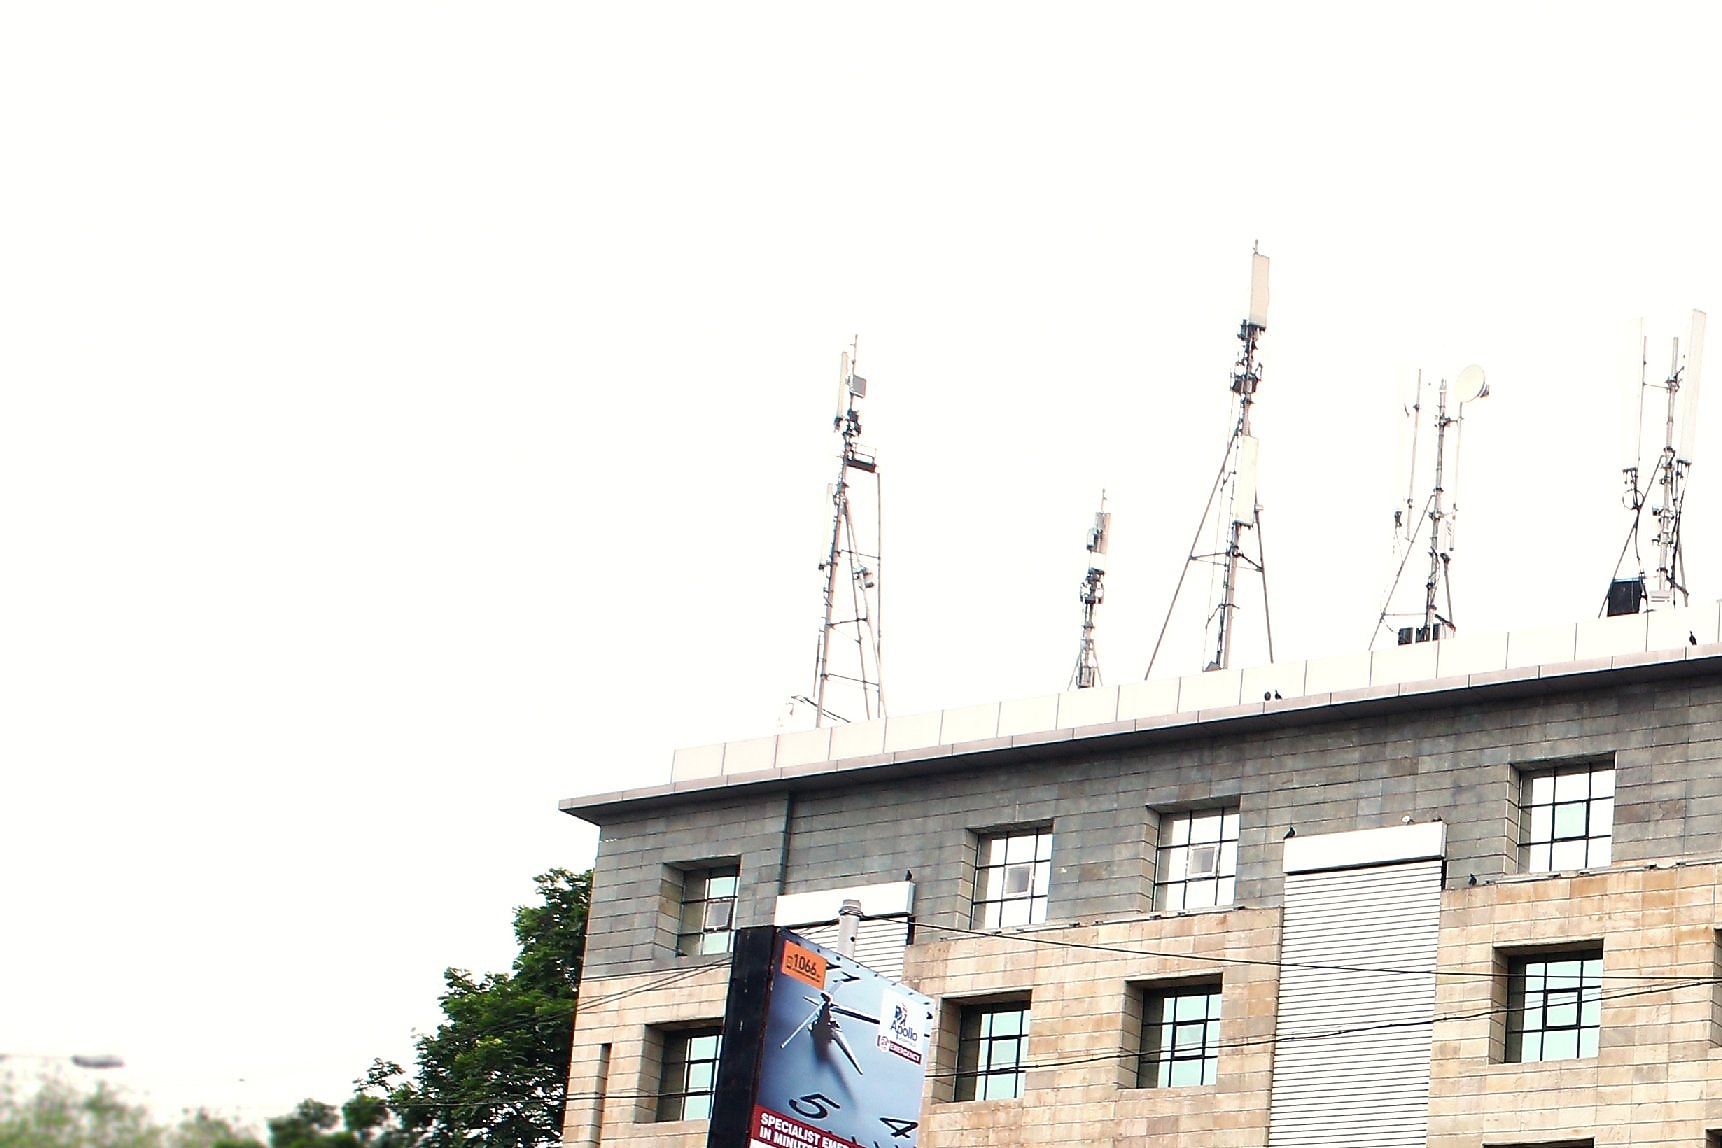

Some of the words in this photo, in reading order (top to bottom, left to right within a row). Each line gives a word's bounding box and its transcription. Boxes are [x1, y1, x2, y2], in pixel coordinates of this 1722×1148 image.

[890, 1020, 918, 1041] Apollo
[760, 1127, 771, 1141] IN
[761, 1113, 820, 1145] SPECIALIST
